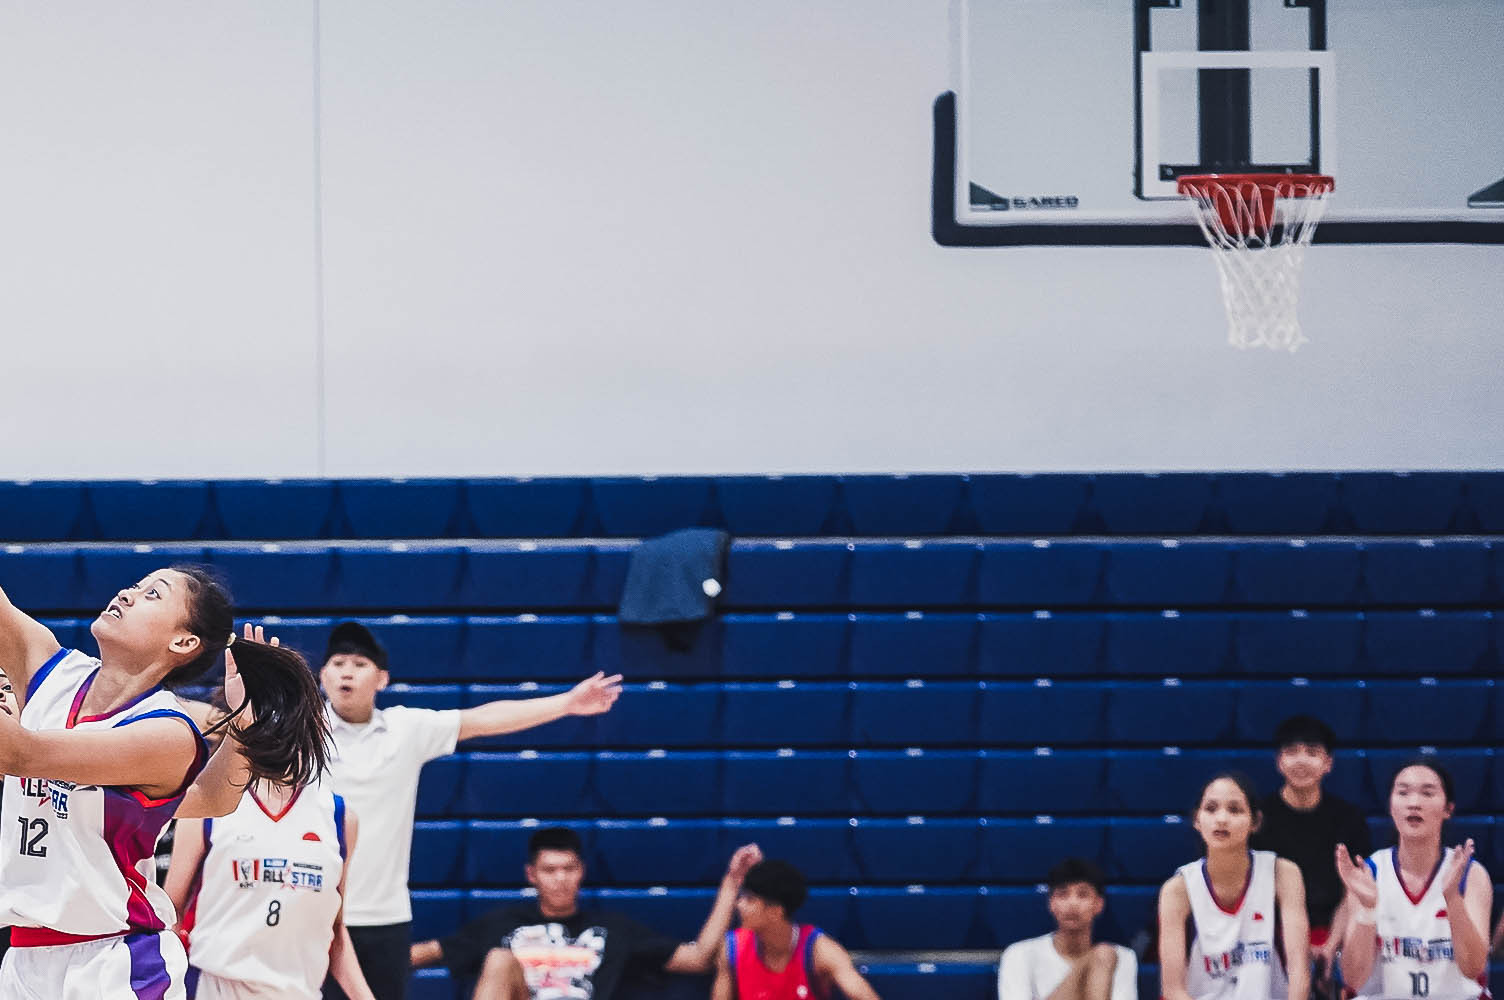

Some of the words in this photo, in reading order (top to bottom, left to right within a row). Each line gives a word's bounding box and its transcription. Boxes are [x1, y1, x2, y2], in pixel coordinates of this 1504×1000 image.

[18, 816, 49, 857] 12
[263, 869, 285, 883] ALL
[291, 871, 323, 888] STAR
[266, 899, 281, 927] 8
[1408, 970, 1429, 998] 10
